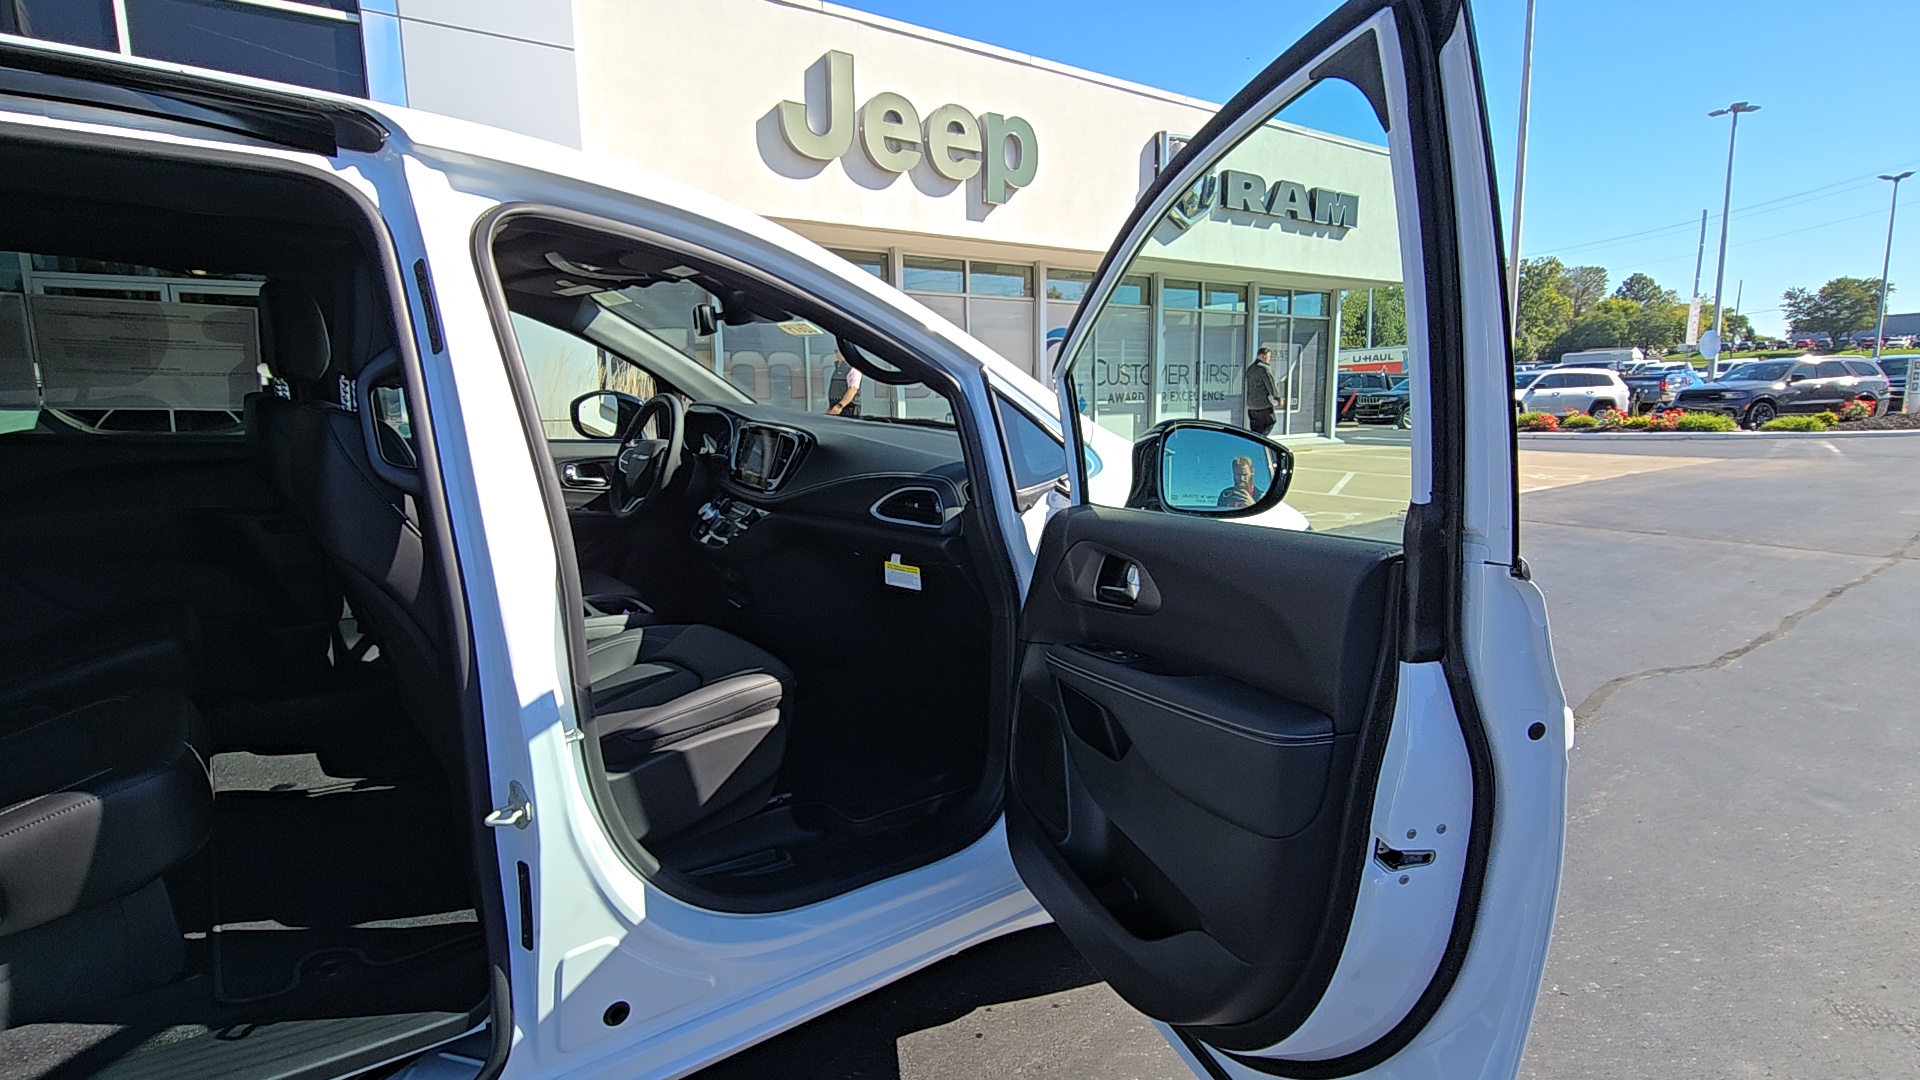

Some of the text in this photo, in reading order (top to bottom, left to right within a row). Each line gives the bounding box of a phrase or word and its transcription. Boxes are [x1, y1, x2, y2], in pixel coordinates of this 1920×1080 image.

[778, 49, 1038, 205] Jeep
[1222, 169, 1359, 228] RAM
[1352, 353, 1394, 363] U-HAUL
[1108, 391, 1145, 404] AWARD
